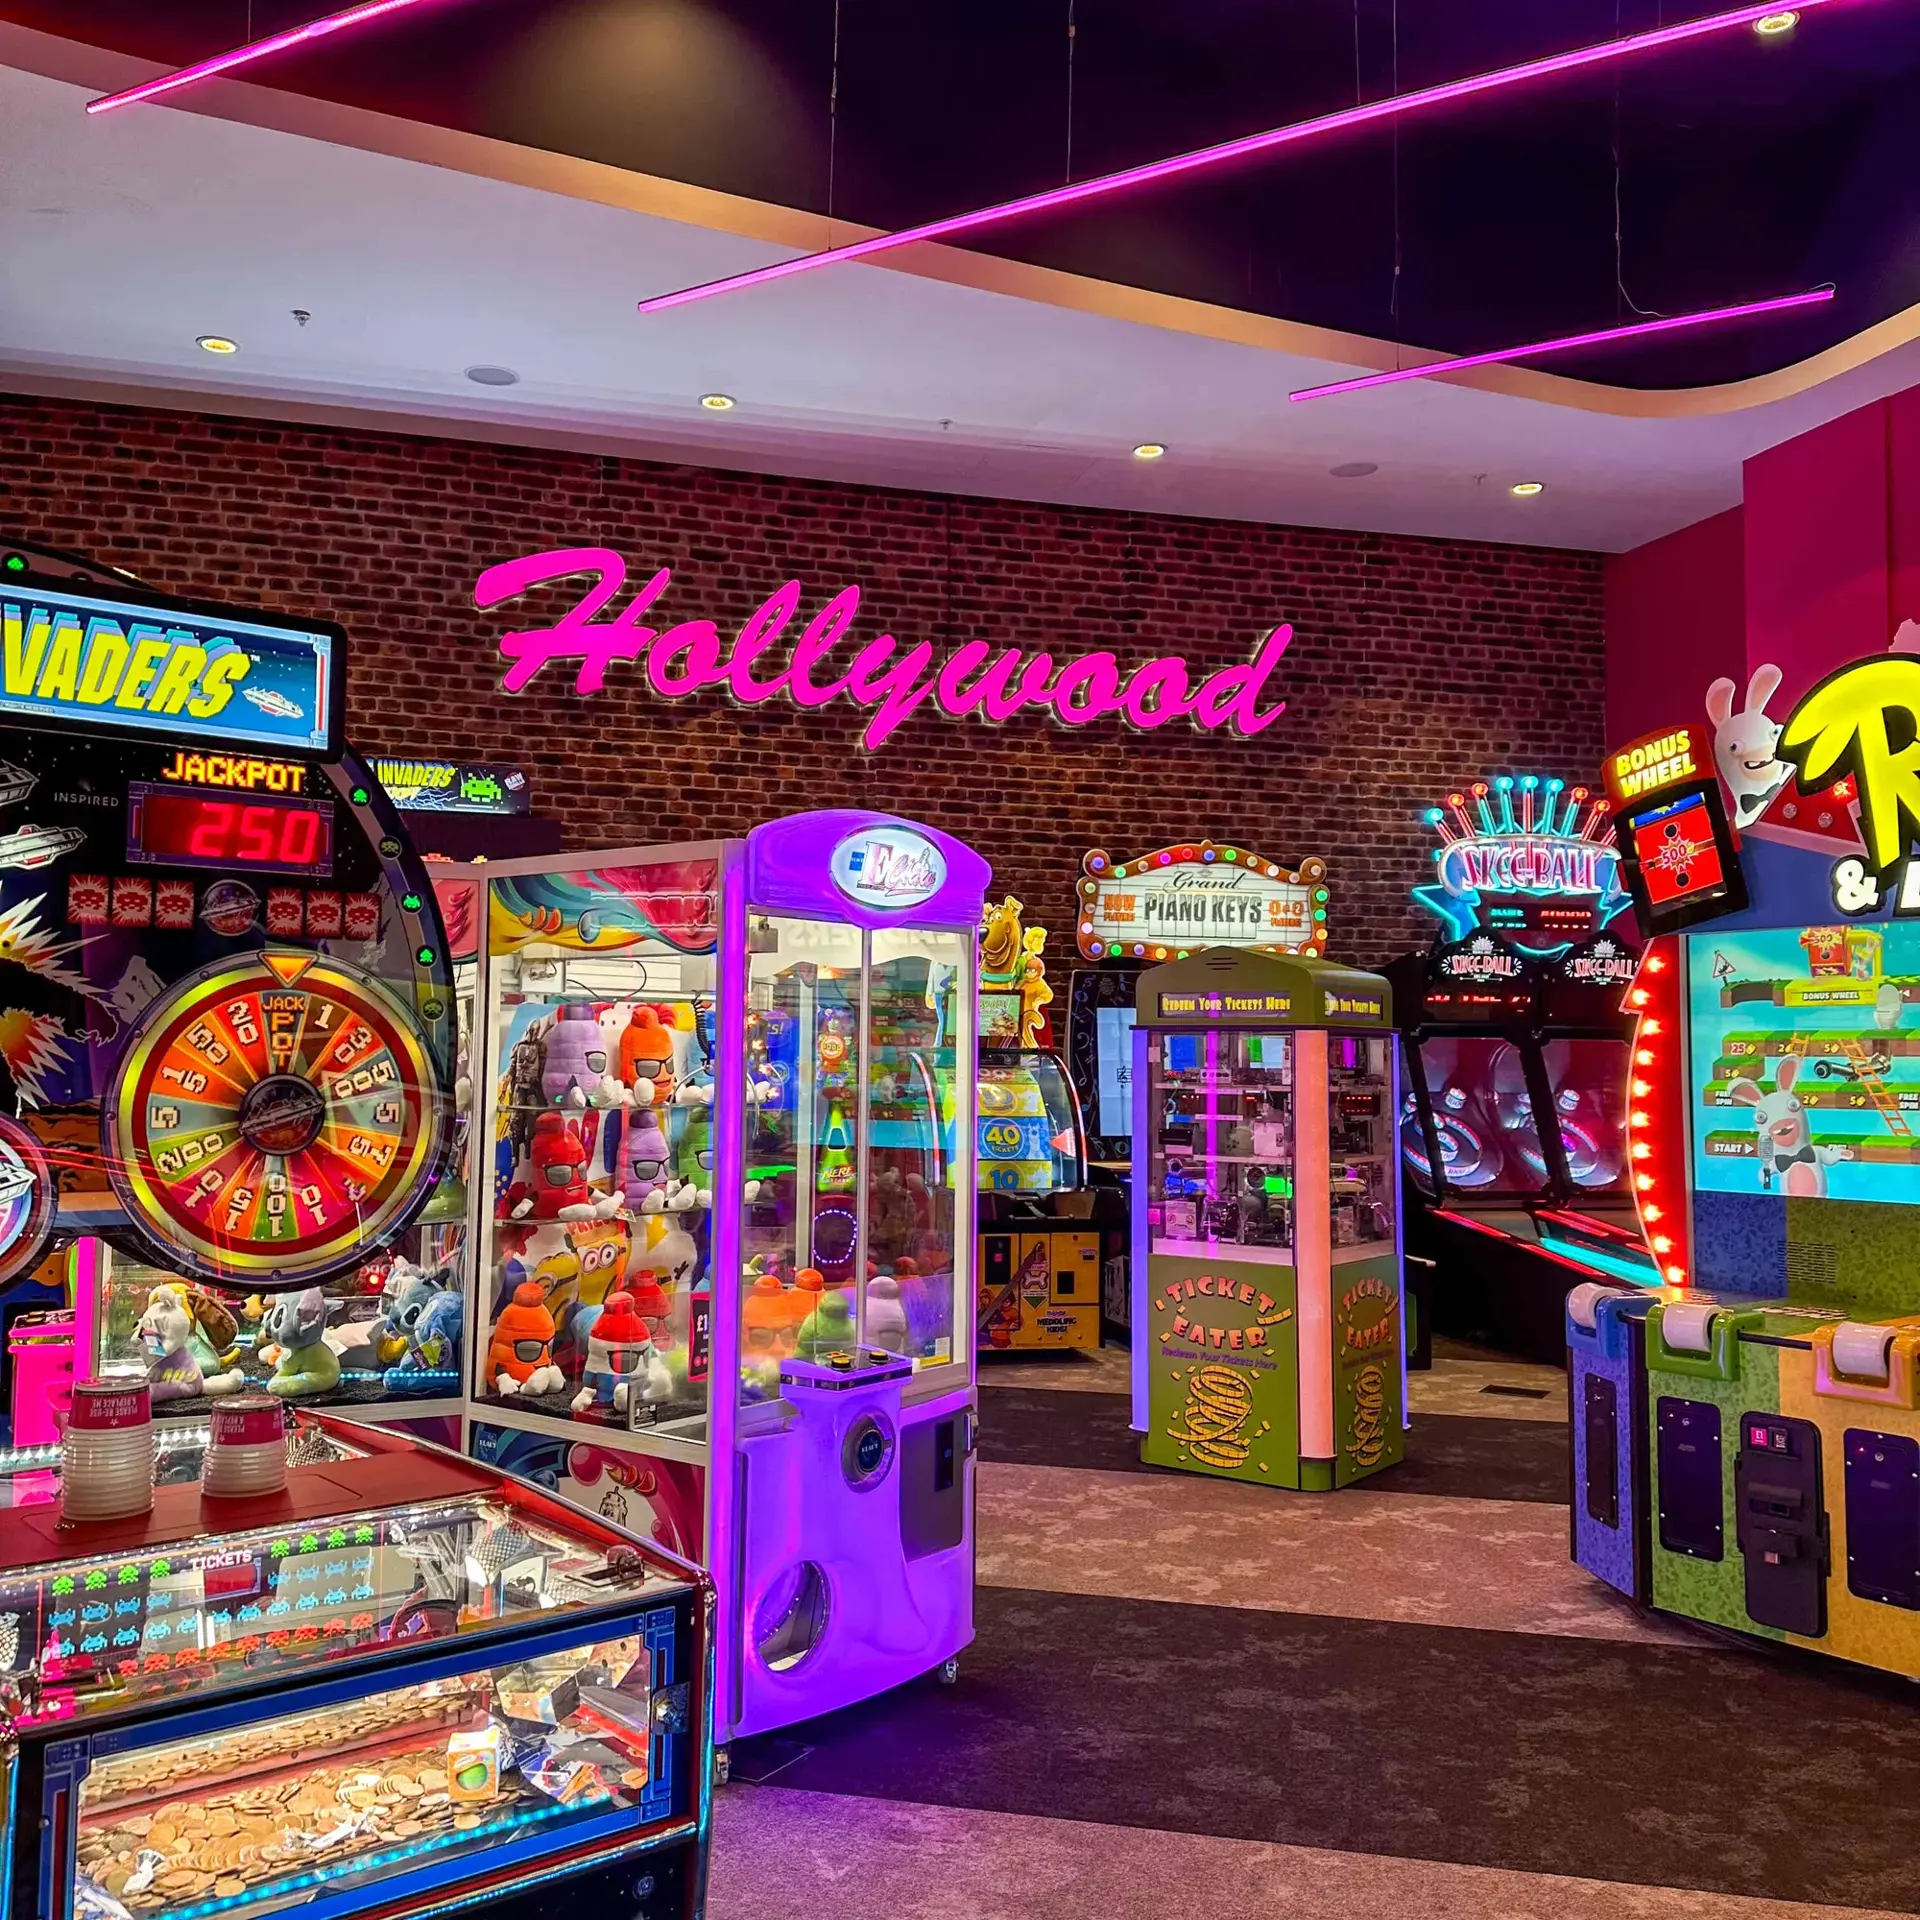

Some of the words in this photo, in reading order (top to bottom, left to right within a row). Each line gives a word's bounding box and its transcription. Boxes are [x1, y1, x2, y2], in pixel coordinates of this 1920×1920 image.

[474, 547, 1293, 752] Hollywood
[1616, 730, 1691, 778] BONUS
[163, 752, 306, 792] JACKPOT
[376, 760, 456, 788] INVADERS
[1620, 752, 1696, 798] WHEEL
[54, 791, 119, 807] INSPIRED
[190, 802, 320, 864] 250
[1662, 844, 1688, 866] 500
[1163, 871, 1246, 893] Grand
[1836, 858, 1879, 912] &
[1104, 894, 1136, 912] NOW
[1144, 893, 1206, 923] PIANO
[1211, 895, 1262, 924] KEYS
[1814, 933, 1833, 944] 500
[262, 996, 305, 1011] JACK
[1199, 997, 1222, 1011] YOUR
[1225, 997, 1263, 1011] TICKETS
[1803, 992, 1830, 1000] BONUS
[1831, 991, 1859, 1000] WHEEL
[227, 1000, 259, 1045] 20
[314, 1003, 334, 1029] 1
[185, 1021, 230, 1066] 50
[335, 1026, 372, 1063] 30
[1731, 1043, 1745, 1054] 25
[1824, 1044, 1831, 1053] 5
[161, 1066, 208, 1093] 15
[335, 1060, 395, 1098] 500
[1725, 1069, 1732, 1078] 5
[1715, 1098, 1733, 1106] SPIN
[1803, 1096, 1810, 1105] 2
[1850, 1096, 1857, 1106] 5
[1899, 1093, 1919, 1101] FREE
[1899, 1101, 1919, 1110] SPIN
[151, 1106, 179, 1129] 5
[376, 1102, 399, 1123] 5
[986, 1126, 1021, 1145] 40
[157, 1132, 224, 1175] 200
[350, 1135, 392, 1167] 15
[991, 1144, 1020, 1153] TICKETS
[1714, 1143, 1743, 1153] START
[822, 1166, 854, 1180] NERF
[990, 1169, 1019, 1187] 10
[184, 1169, 224, 1208] 10
[224, 1187, 254, 1232] 15
[266, 1173, 287, 1237] 100
[300, 1184, 328, 1226] 10
[1165, 1275, 1277, 1316] TICKET
[1172, 1315, 1268, 1350] EATER
[1347, 1317, 1390, 1349] EATER
[115, 1405, 138, 1416] PLEASE
[189, 1549, 253, 1571] TICKETS
